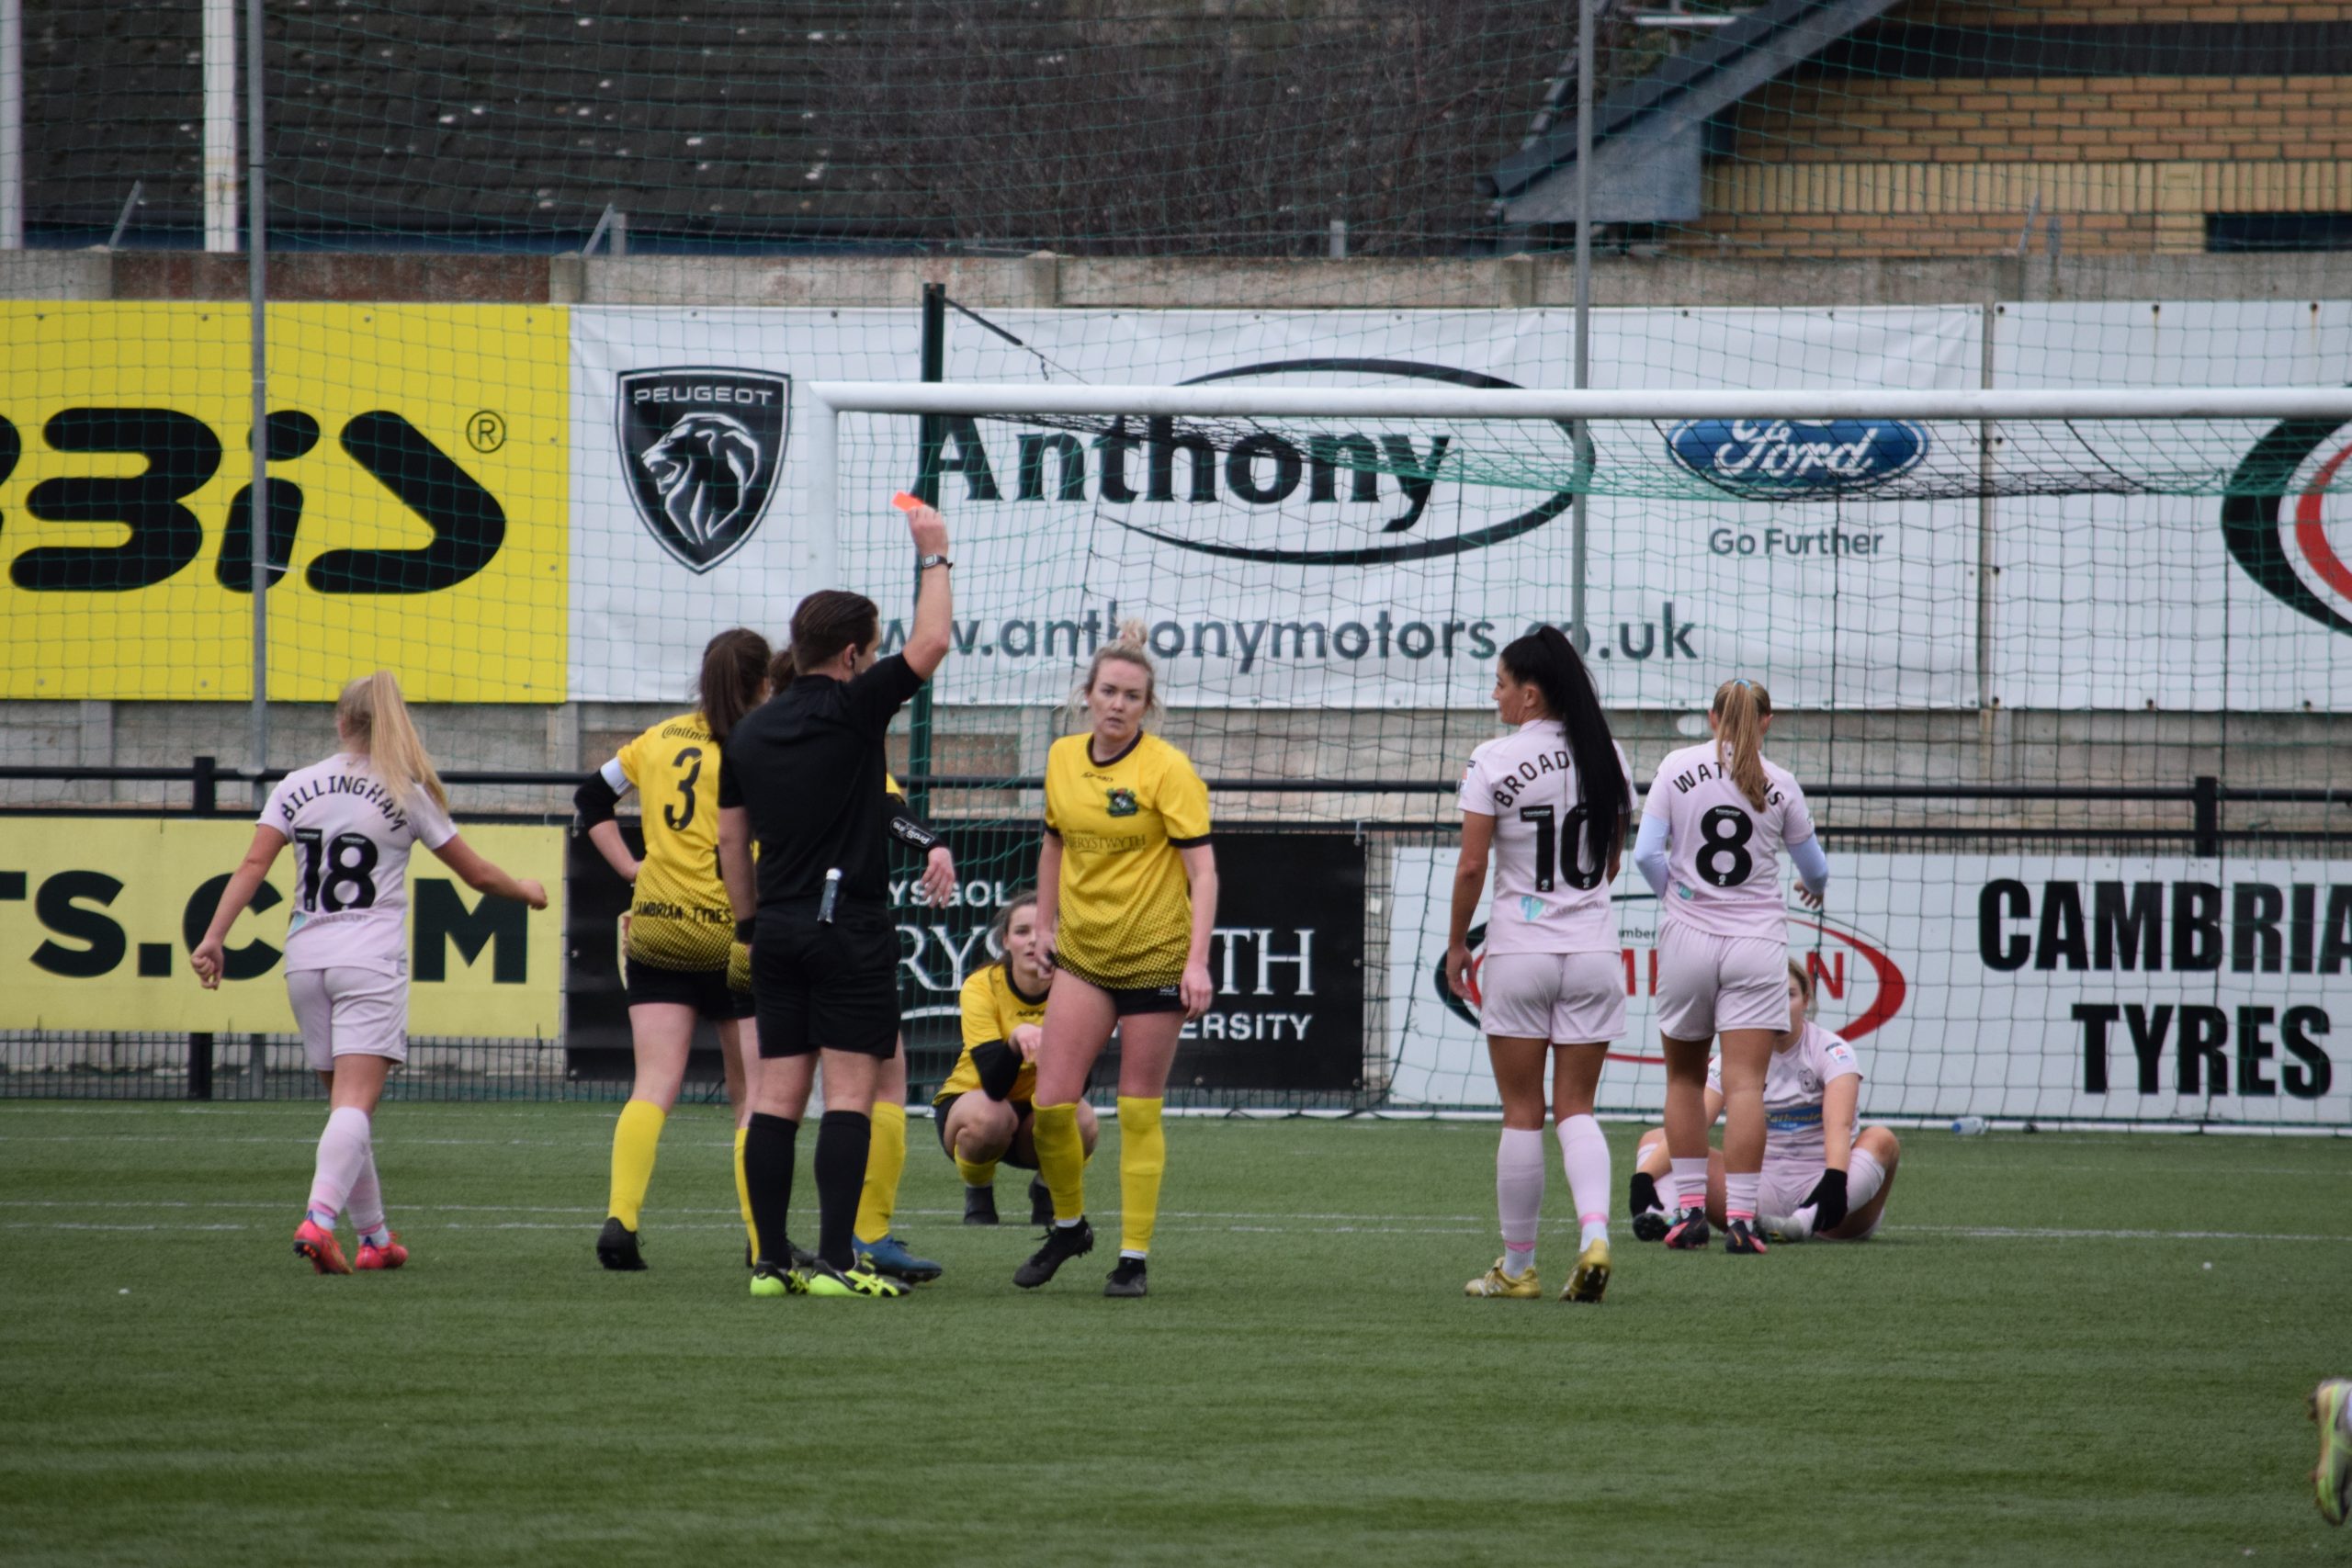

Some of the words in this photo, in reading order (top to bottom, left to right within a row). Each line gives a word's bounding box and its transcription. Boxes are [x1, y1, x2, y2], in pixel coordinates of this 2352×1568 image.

[634, 386, 773, 405] PEUGEOT
[911, 414, 1452, 533] Anthony
[1713, 419, 1880, 478] Ford
[1709, 527, 1756, 556] Go
[1764, 527, 1884, 556] Further
[281, 775, 408, 832] BILLINGHAM
[663, 747, 702, 832] 3
[294, 829, 378, 913] 18
[1520, 804, 1609, 893] 10
[1696, 805, 1753, 887] 8
[2071, 1003, 2333, 1099] TYRES
